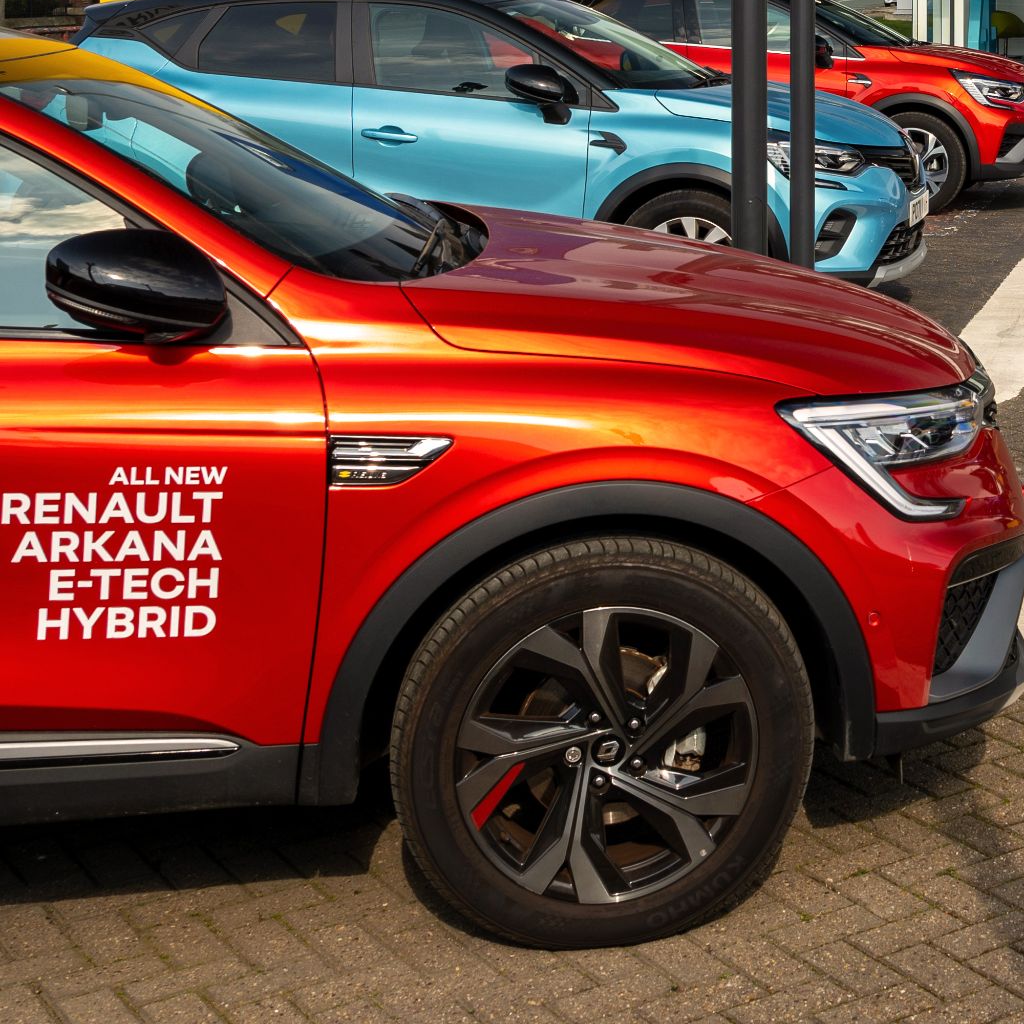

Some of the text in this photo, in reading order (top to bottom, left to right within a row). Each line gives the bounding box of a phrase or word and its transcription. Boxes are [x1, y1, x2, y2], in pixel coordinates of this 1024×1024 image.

[108, 466, 228, 485] ALL NEW
[0, 491, 224, 524] RENAULT
[10, 530, 223, 563] ARKANA
[48, 567, 220, 601] E-TECH
[36, 605, 217, 640] HYBRID
